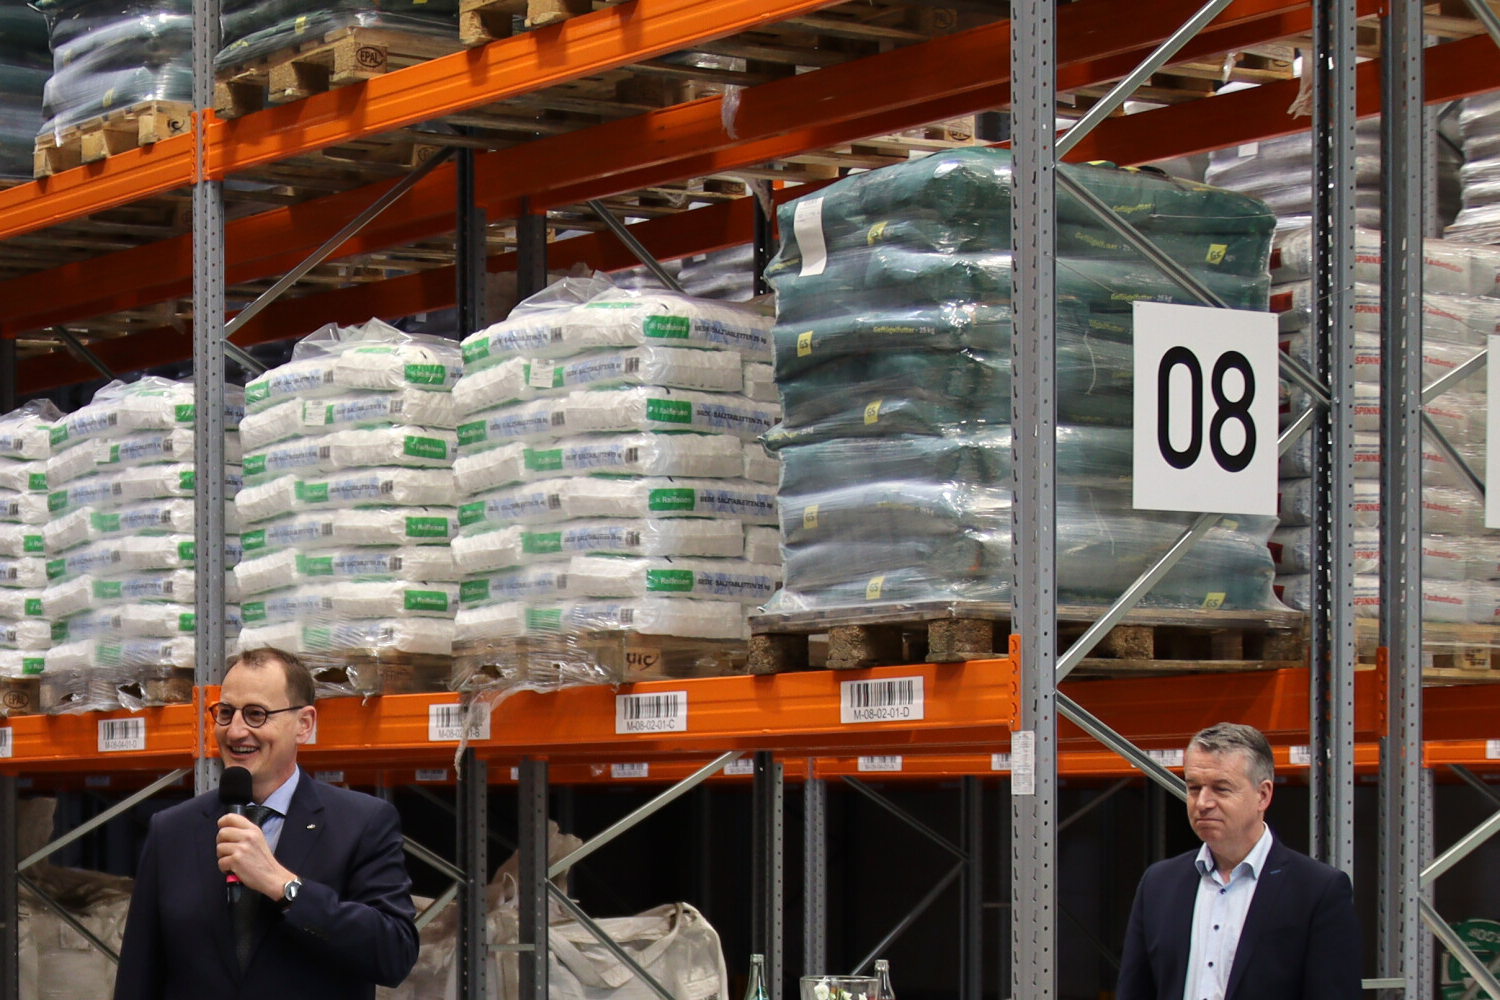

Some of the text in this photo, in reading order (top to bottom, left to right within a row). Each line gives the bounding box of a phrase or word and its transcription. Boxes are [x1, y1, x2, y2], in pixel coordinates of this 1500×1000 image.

[360, 51, 380, 64] EPAL
[1210, 251, 1222, 260] GS
[873, 326, 915, 334] Geflügelfutter
[799, 339, 809, 349] GS
[866, 406, 877, 416] GS
[1158, 346, 1256, 472] 08
[661, 496, 692, 504] Raiffeisen
[805, 512, 815, 522] GS
[660, 577, 690, 585] Raiffeisen
[869, 583, 879, 593] GS
[8, 695, 27, 706] EPAL
[853, 706, 910, 721] M-08-02-01-D
[626, 719, 675, 732] M-08-02-01-C
